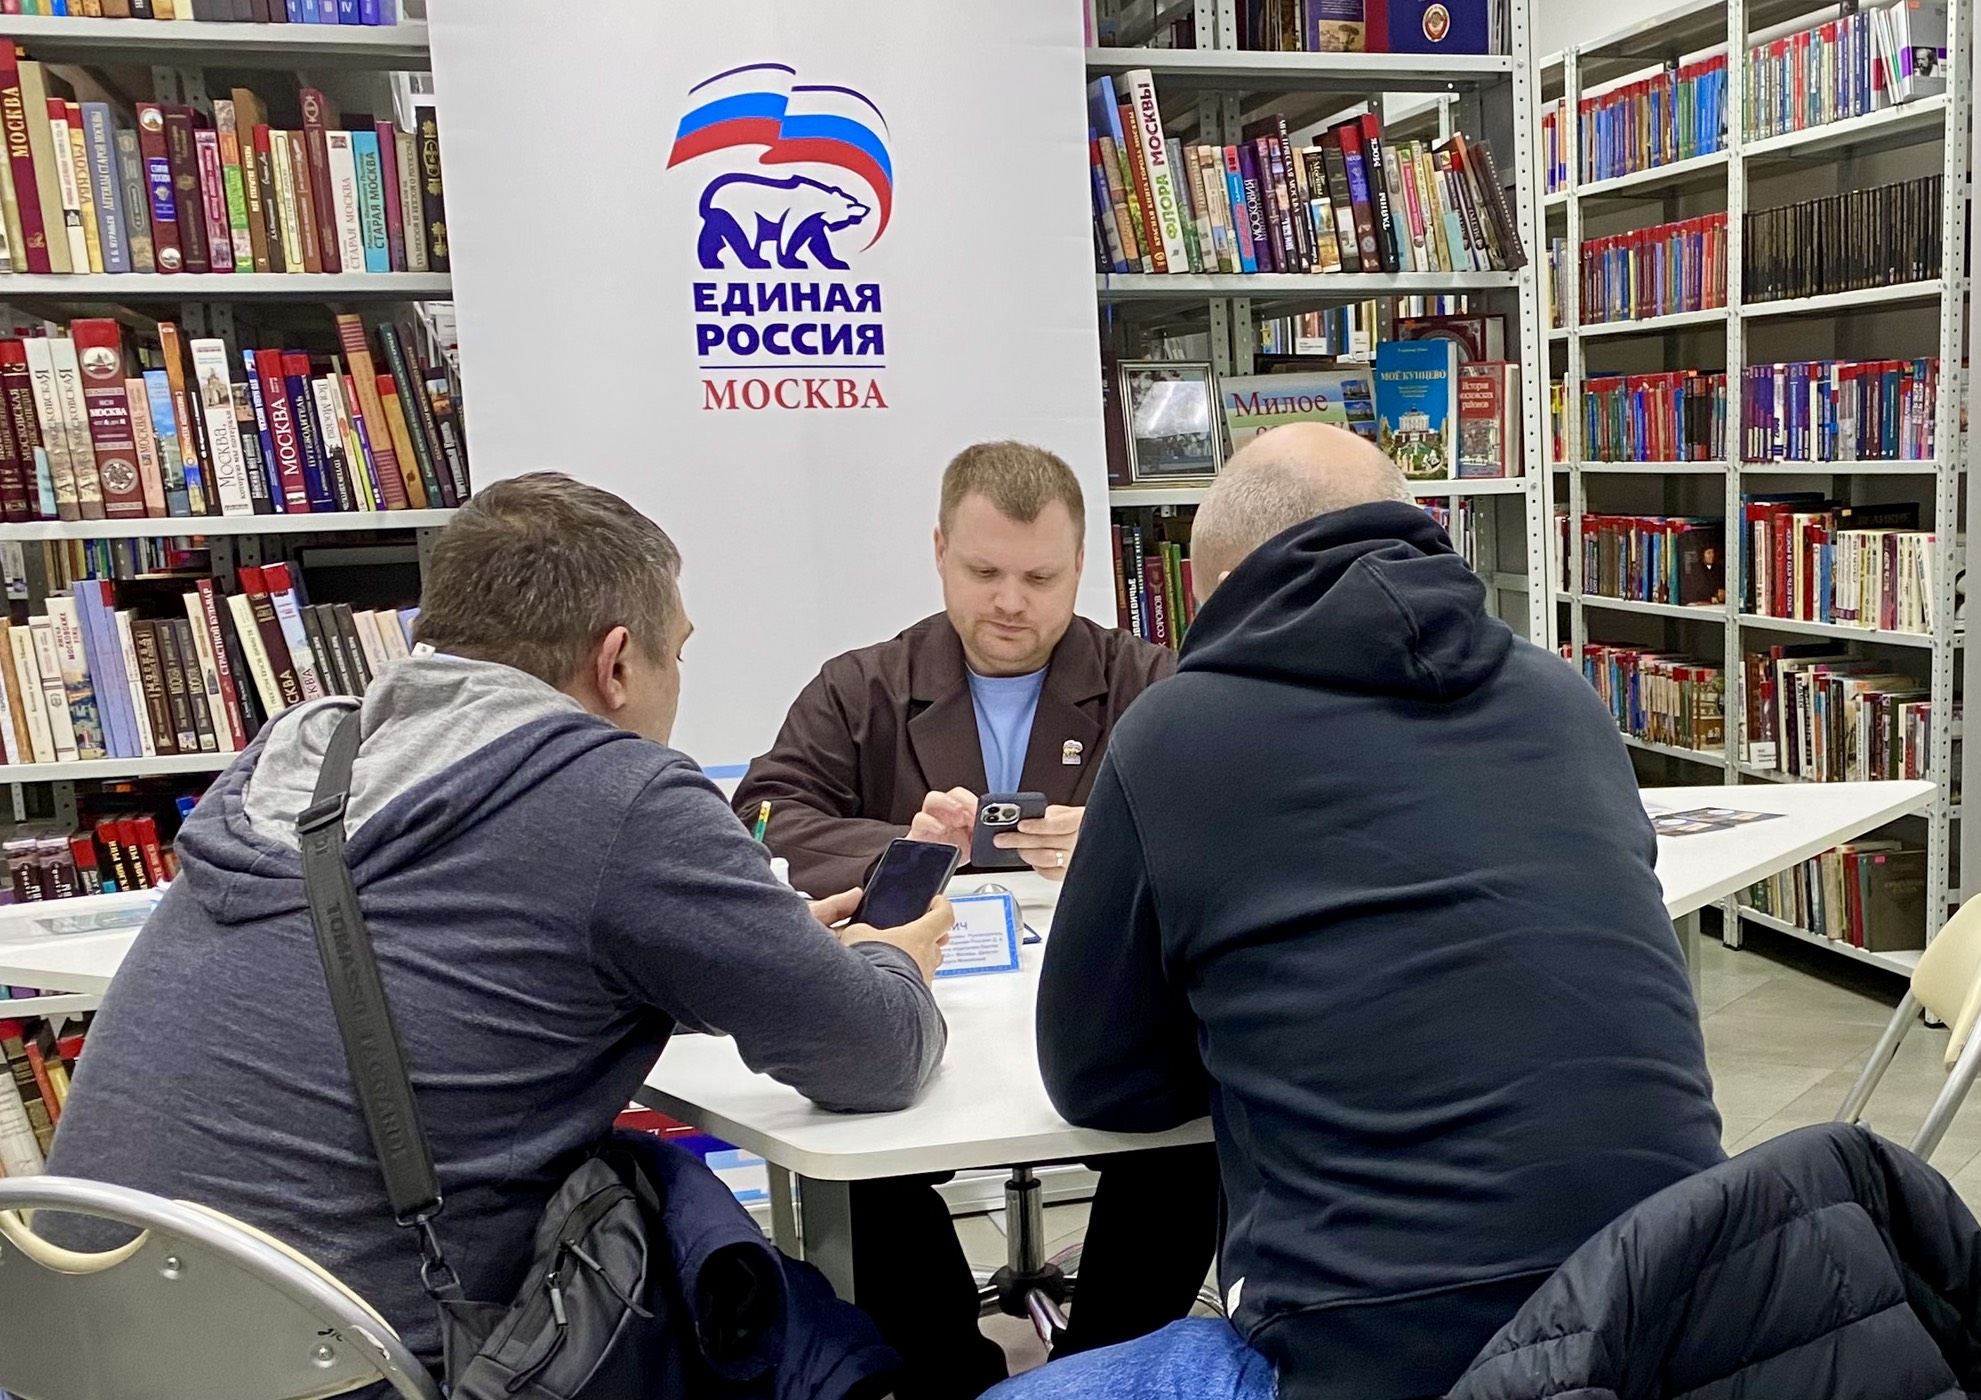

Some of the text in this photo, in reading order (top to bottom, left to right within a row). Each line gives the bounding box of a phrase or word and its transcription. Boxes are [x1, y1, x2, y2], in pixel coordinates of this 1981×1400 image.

[1, 86, 30, 157] МОСКВА
[90, 111, 105, 143] МОСКВЫ
[72, 143, 92, 204] МОСКВА
[94, 144, 110, 174] СТАРОЙ
[1128, 111, 1161, 246] КРАСНАЯ КНИГА ГОРОДА МОСКВЫ
[1137, 82, 1178, 239] ФЛОРА МОСКВЫ
[1279, 119, 1301, 212] МИСТИЧЕСКАЯ МОСКВА
[365, 151, 384, 249] СТАРАЯ МОСКВА
[1370, 137, 1390, 230] ТАЙНЫ МОСК
[341, 177, 361, 269] СТАРАЯ МОСКВА
[1244, 179, 1263, 241] МОСКОВИЯ
[693, 282, 882, 317] ЕДИНАЯ
[696, 323, 885, 356] РОССИЯ
[702, 378, 889, 410] МОСКВА
[1403, 370, 1446, 381] КУНЦЕВО
[1462, 382, 1489, 391] История
[9, 388, 32, 461] МОСКОВСКАЯ
[1231, 391, 1328, 417] Милое
[1462, 402, 1489, 411] районов
[135, 415, 150, 454] МОСКВА
[270, 398, 299, 475] МОСКВА
[296, 395, 316, 467] ПУТЕВОДИТЕЛЬ
[214, 424, 237, 487] Москва,
[60, 612, 75, 660] МОСКОВСКИХ
[203, 587, 230, 675] СТРАСТНОЙ БУЛЬВАР
[1155, 595, 1165, 638] СОРОКОВ
[280, 669, 300, 703] СКВА
[302, 668, 320, 697] КВА
[952, 922, 968, 930] ИЧ
